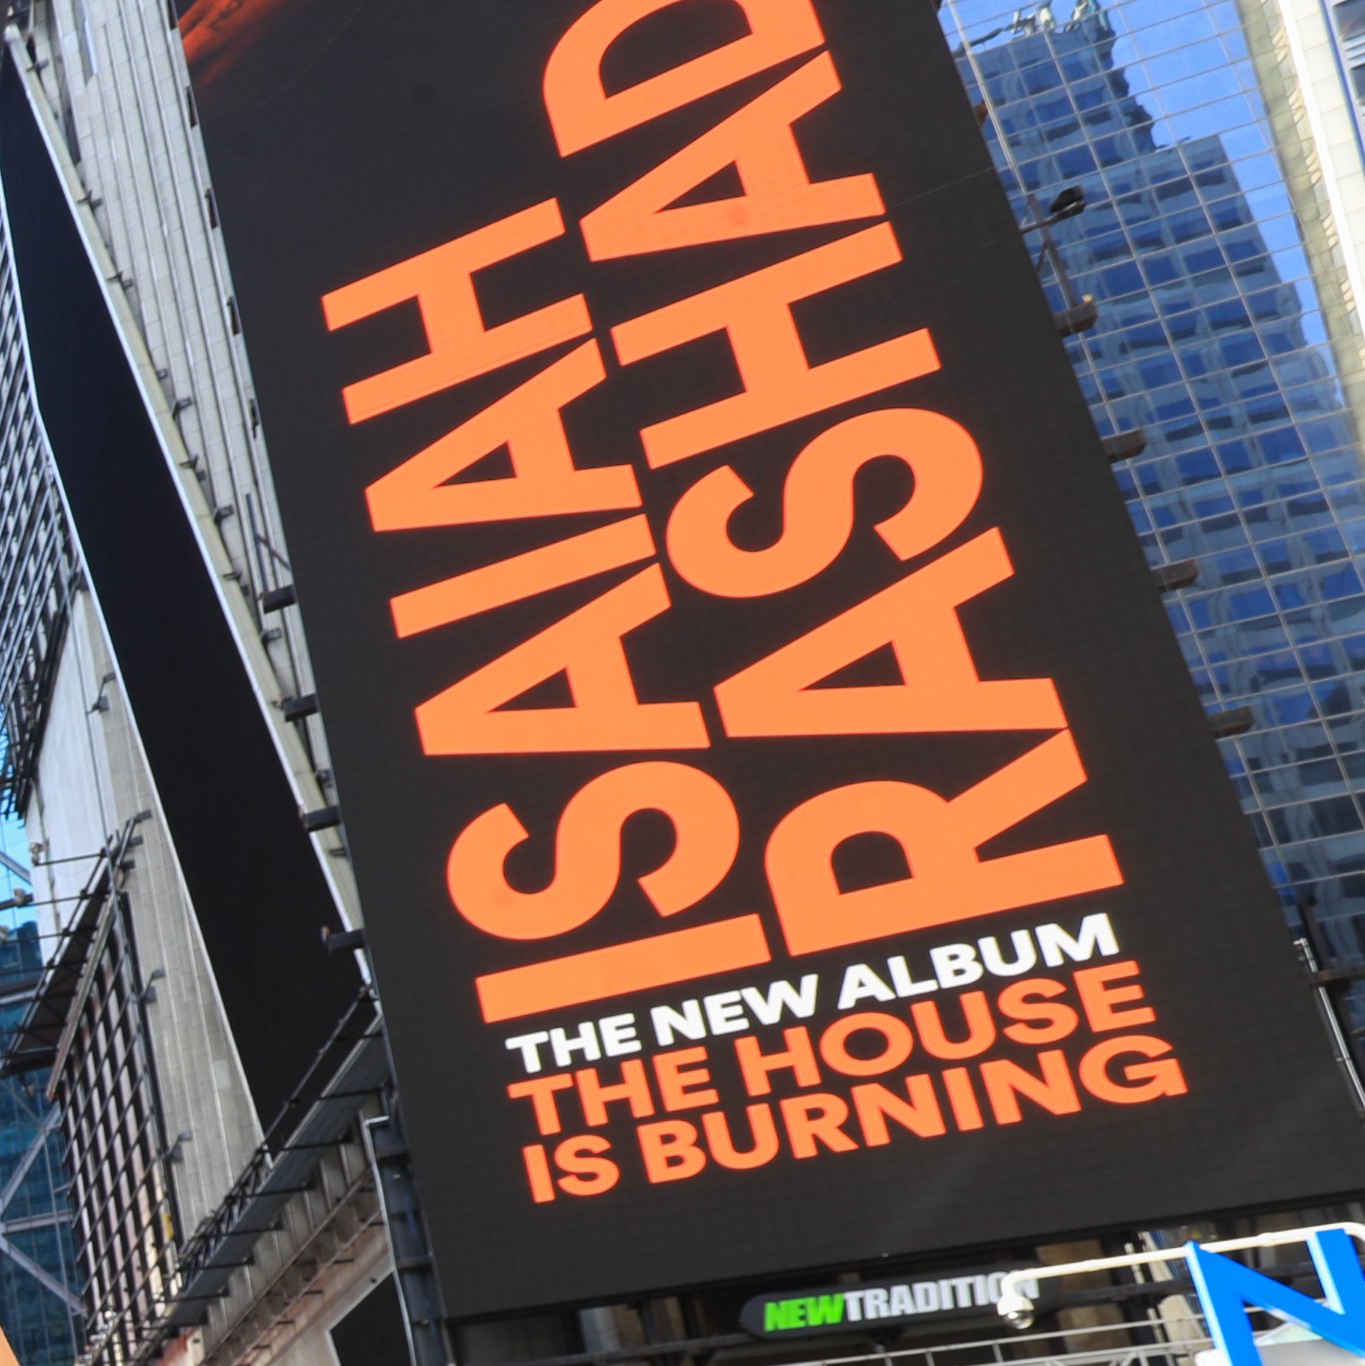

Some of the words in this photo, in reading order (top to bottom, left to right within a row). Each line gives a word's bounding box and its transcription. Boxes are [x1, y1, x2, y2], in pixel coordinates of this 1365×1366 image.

[543, 0, 1124, 957] RASHAD
[322, 198, 772, 1024] ISAIAH
[505, 1013, 642, 1074] THE
[651, 974, 819, 1047] NEW
[837, 912, 1119, 1010] ALBUM
[507, 1046, 719, 1136] THE
[734, 960, 1156, 1097] HOUSE
[523, 1134, 620, 1203] IS
[636, 1034, 1188, 1184] BURNING
